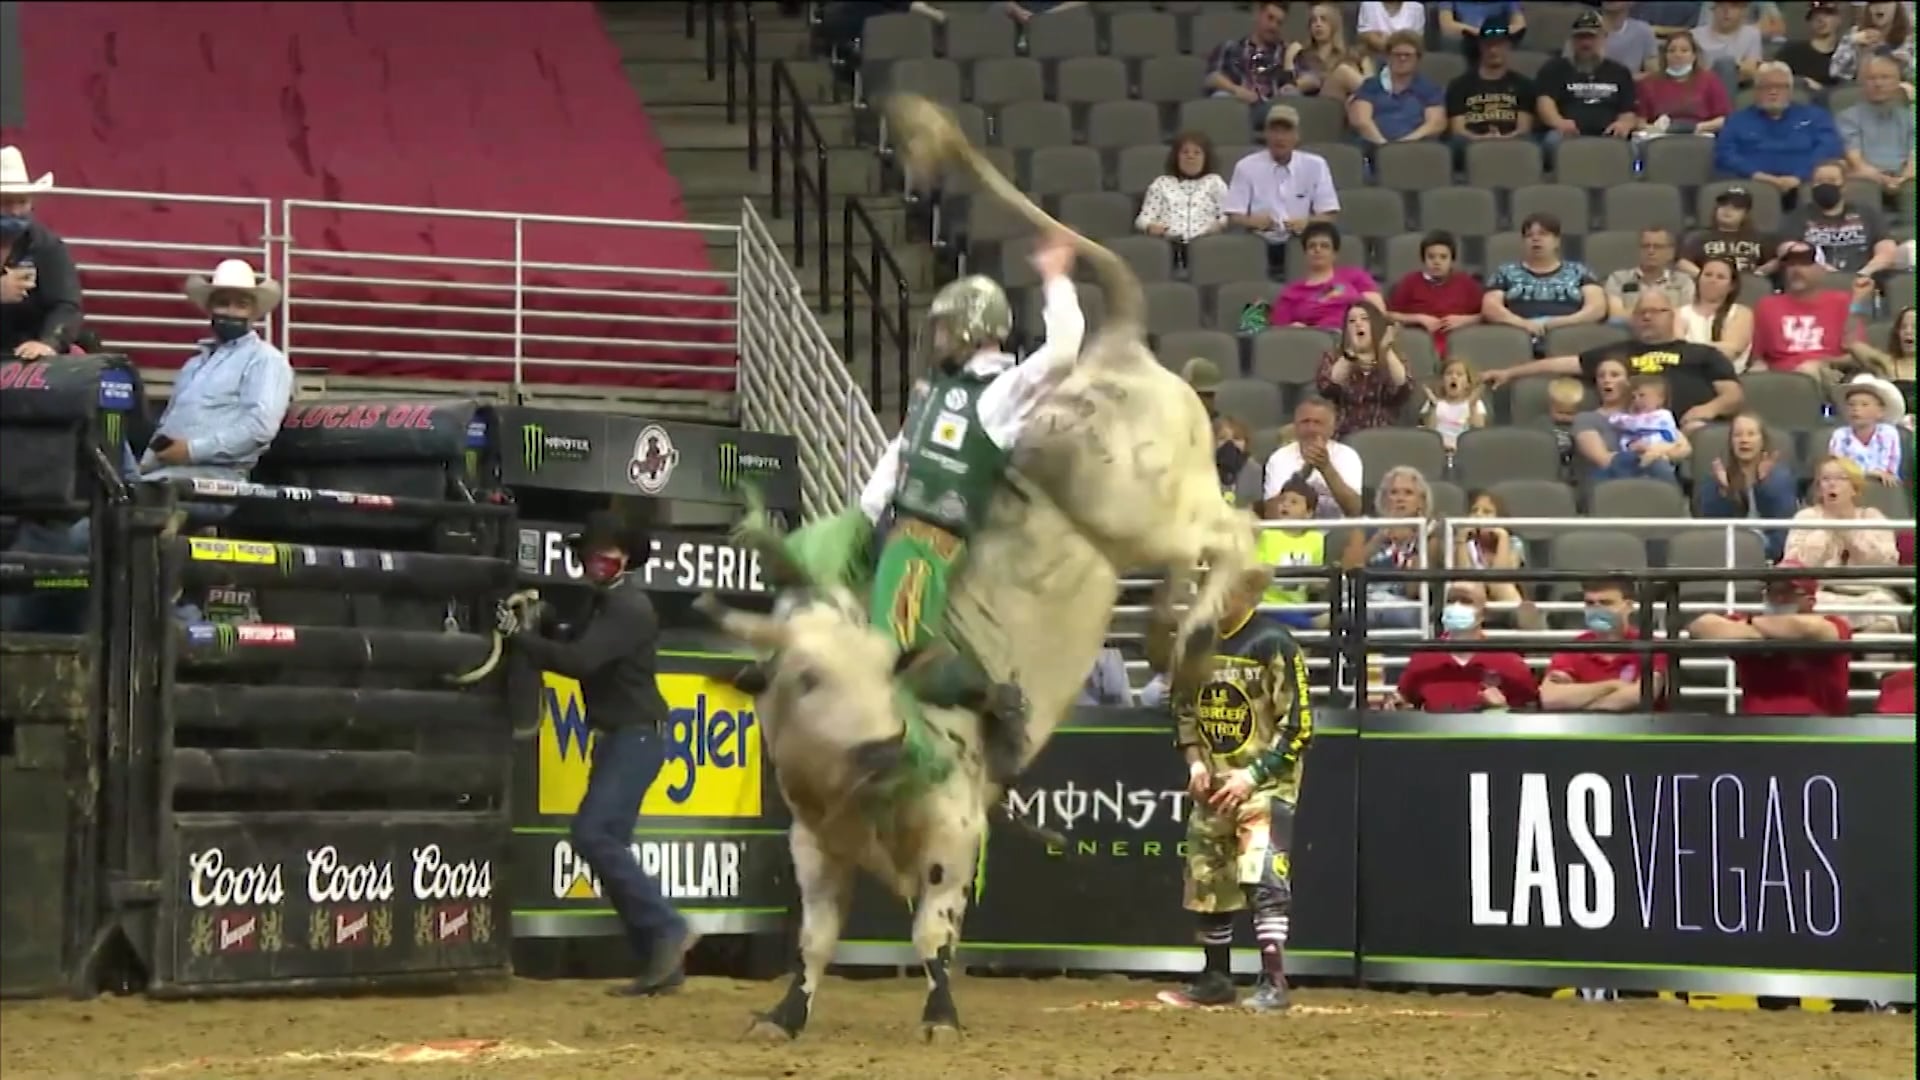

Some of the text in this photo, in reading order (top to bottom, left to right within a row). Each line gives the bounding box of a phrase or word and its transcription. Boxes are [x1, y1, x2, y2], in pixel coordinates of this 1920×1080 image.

[284, 405, 385, 428] LUCAS
[544, 436, 590, 452] MONSTER
[644, 539, 766, 592] F-SERIE
[545, 687, 754, 804] Wgler
[1003, 780, 1190, 829] MONST
[553, 840, 740, 898] CAPILLAR
[1046, 840, 1189, 857] ENER
[1469, 772, 1842, 936] LAS VEGAS
[190, 844, 492, 907] Coors Coors Coors
